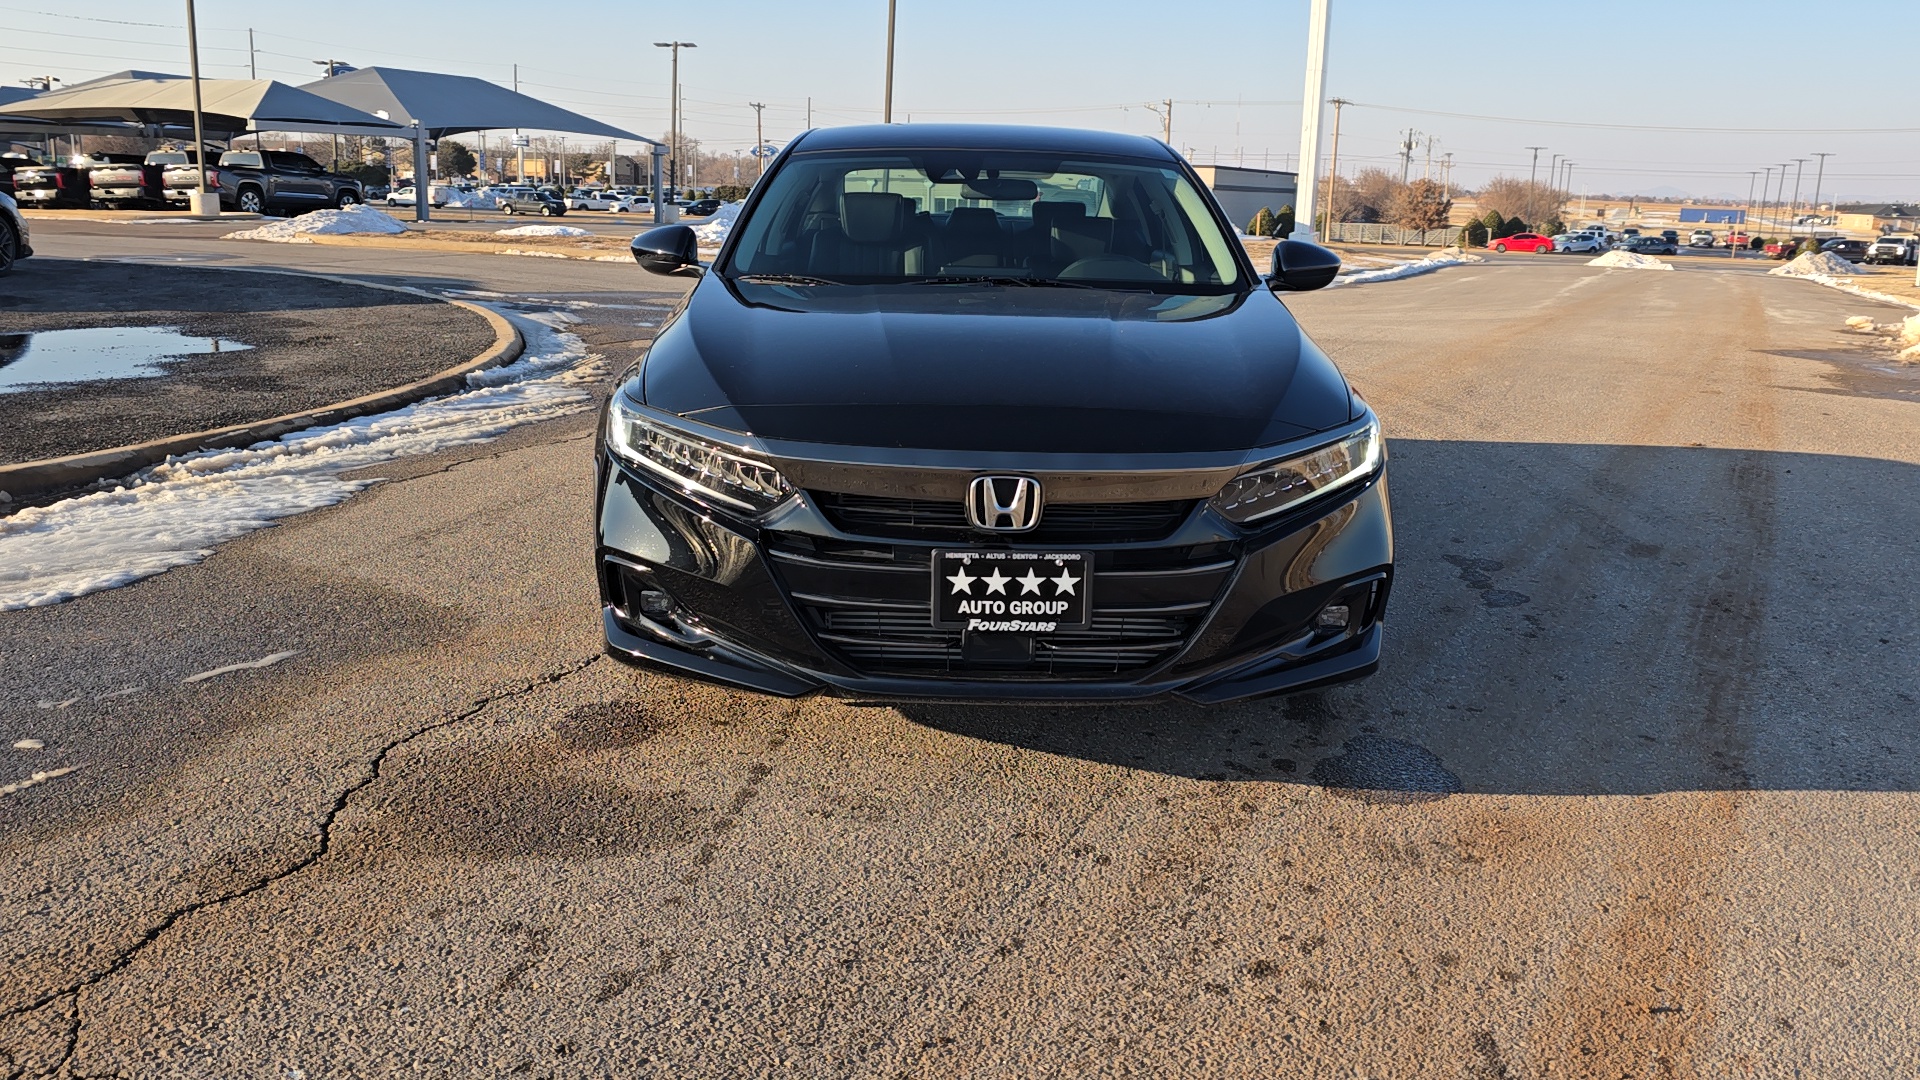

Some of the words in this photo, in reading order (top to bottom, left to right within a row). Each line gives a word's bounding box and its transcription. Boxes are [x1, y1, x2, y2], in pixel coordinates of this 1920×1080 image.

[985, 552, 1006, 560] ALTUS
[1043, 553, 1082, 561] JACKSBORO
[957, 600, 1005, 615] AUTO
[1009, 600, 1069, 615] GROUP
